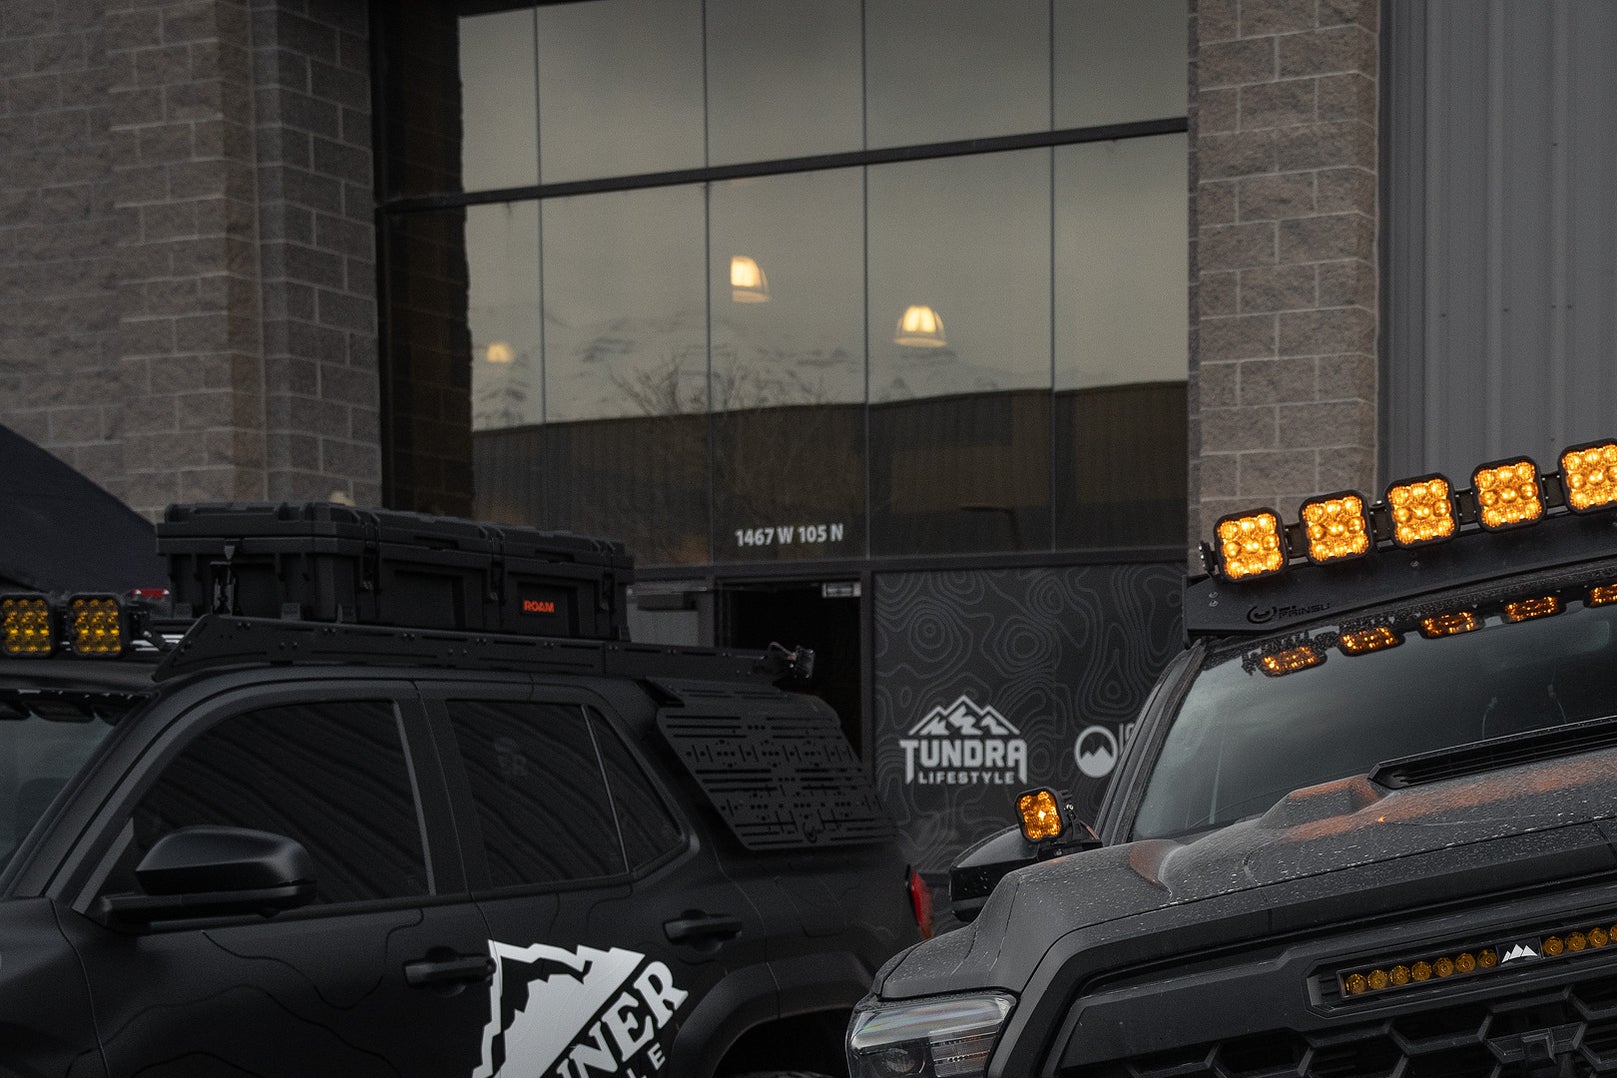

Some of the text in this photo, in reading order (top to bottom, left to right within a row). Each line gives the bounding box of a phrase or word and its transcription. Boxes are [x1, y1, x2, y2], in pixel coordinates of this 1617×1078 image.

[735, 522, 844, 547] 1467 W 105 N
[523, 599, 555, 613] ROAM
[899, 739, 1028, 785] TUNDRA
[918, 771, 1016, 785] LIFESTYLE
